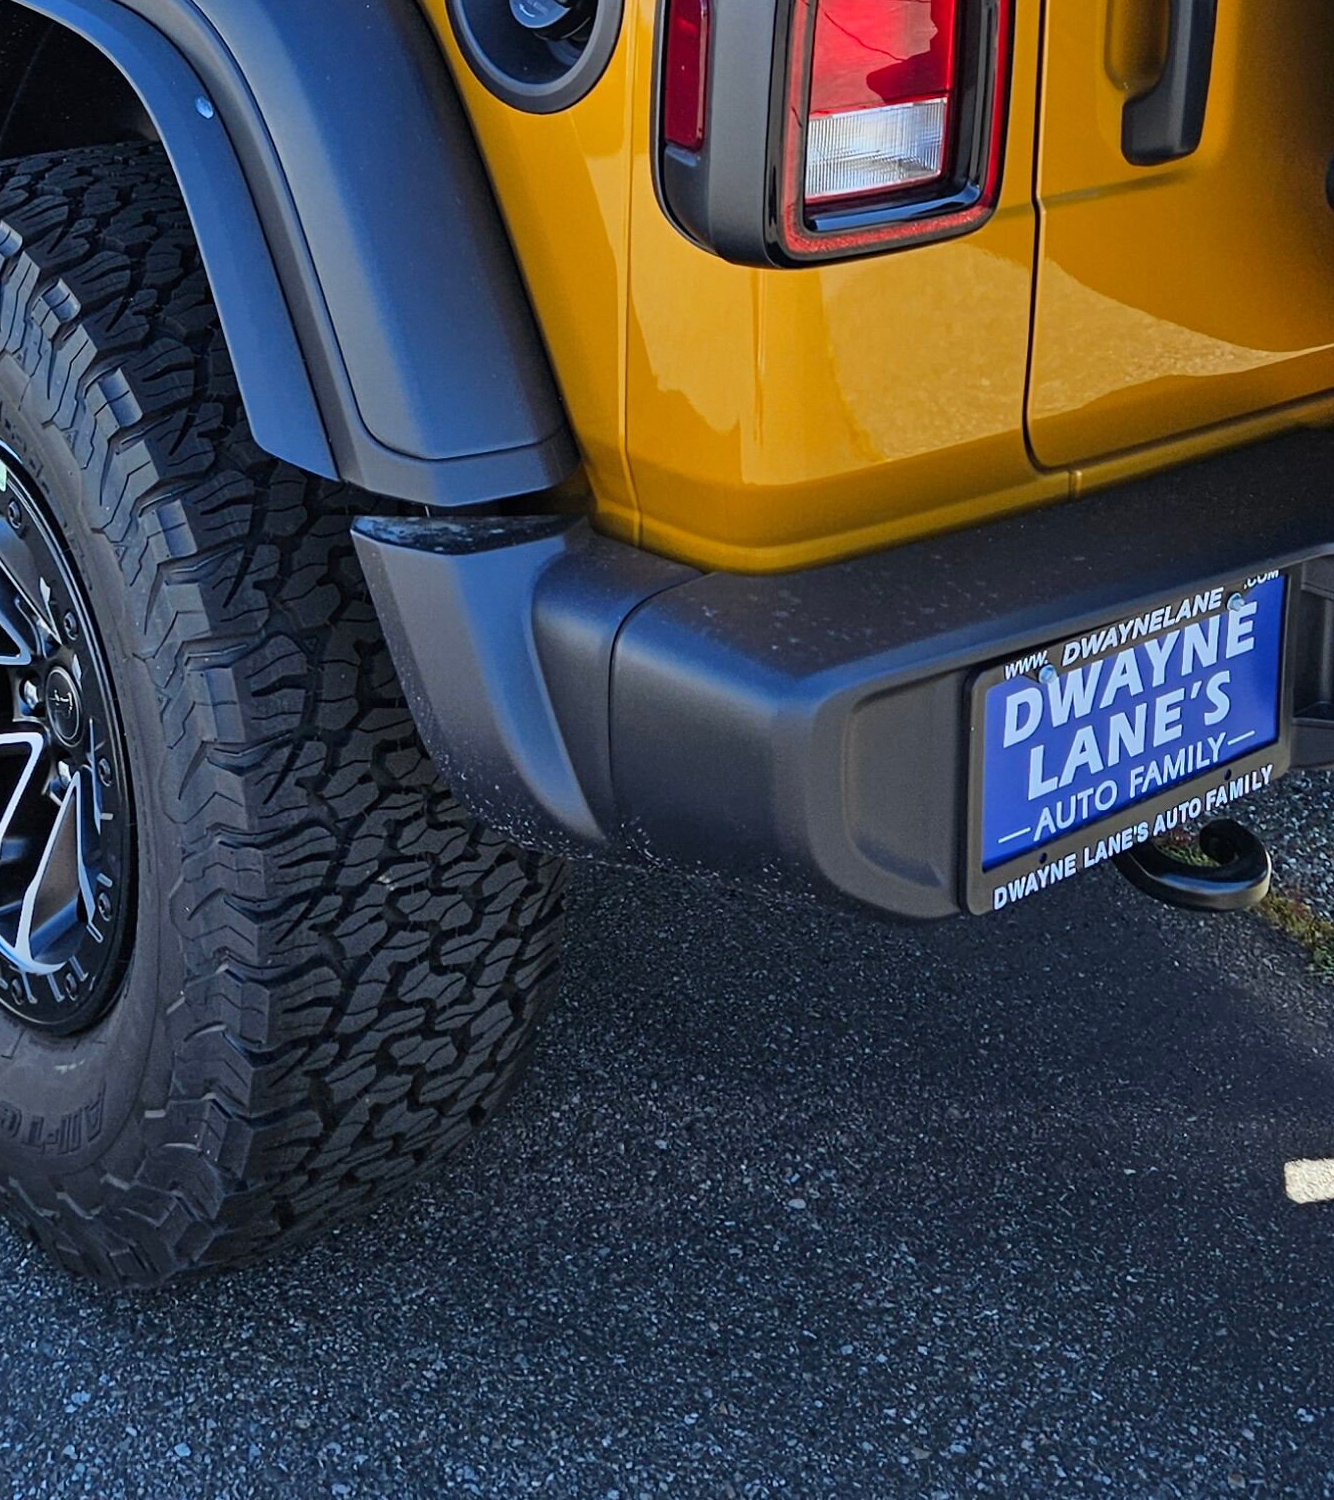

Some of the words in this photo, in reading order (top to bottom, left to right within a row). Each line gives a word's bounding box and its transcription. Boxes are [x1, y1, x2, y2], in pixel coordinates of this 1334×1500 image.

[1003, 601, 1258, 749] DWAYNE
[1004, 651, 1049, 681] WWW.
[1062, 587, 1225, 668] DWAYNELANE
[1027, 670, 1231, 801] LANE'S
[1033, 781, 1118, 842] AUTO
[1129, 731, 1227, 799] FAMILY
[993, 856, 1078, 911] DWAYNE
[1082, 822, 1150, 866] LANE'S
[1153, 796, 1201, 837] AUTO
[1205, 764, 1275, 812] FAMILY
